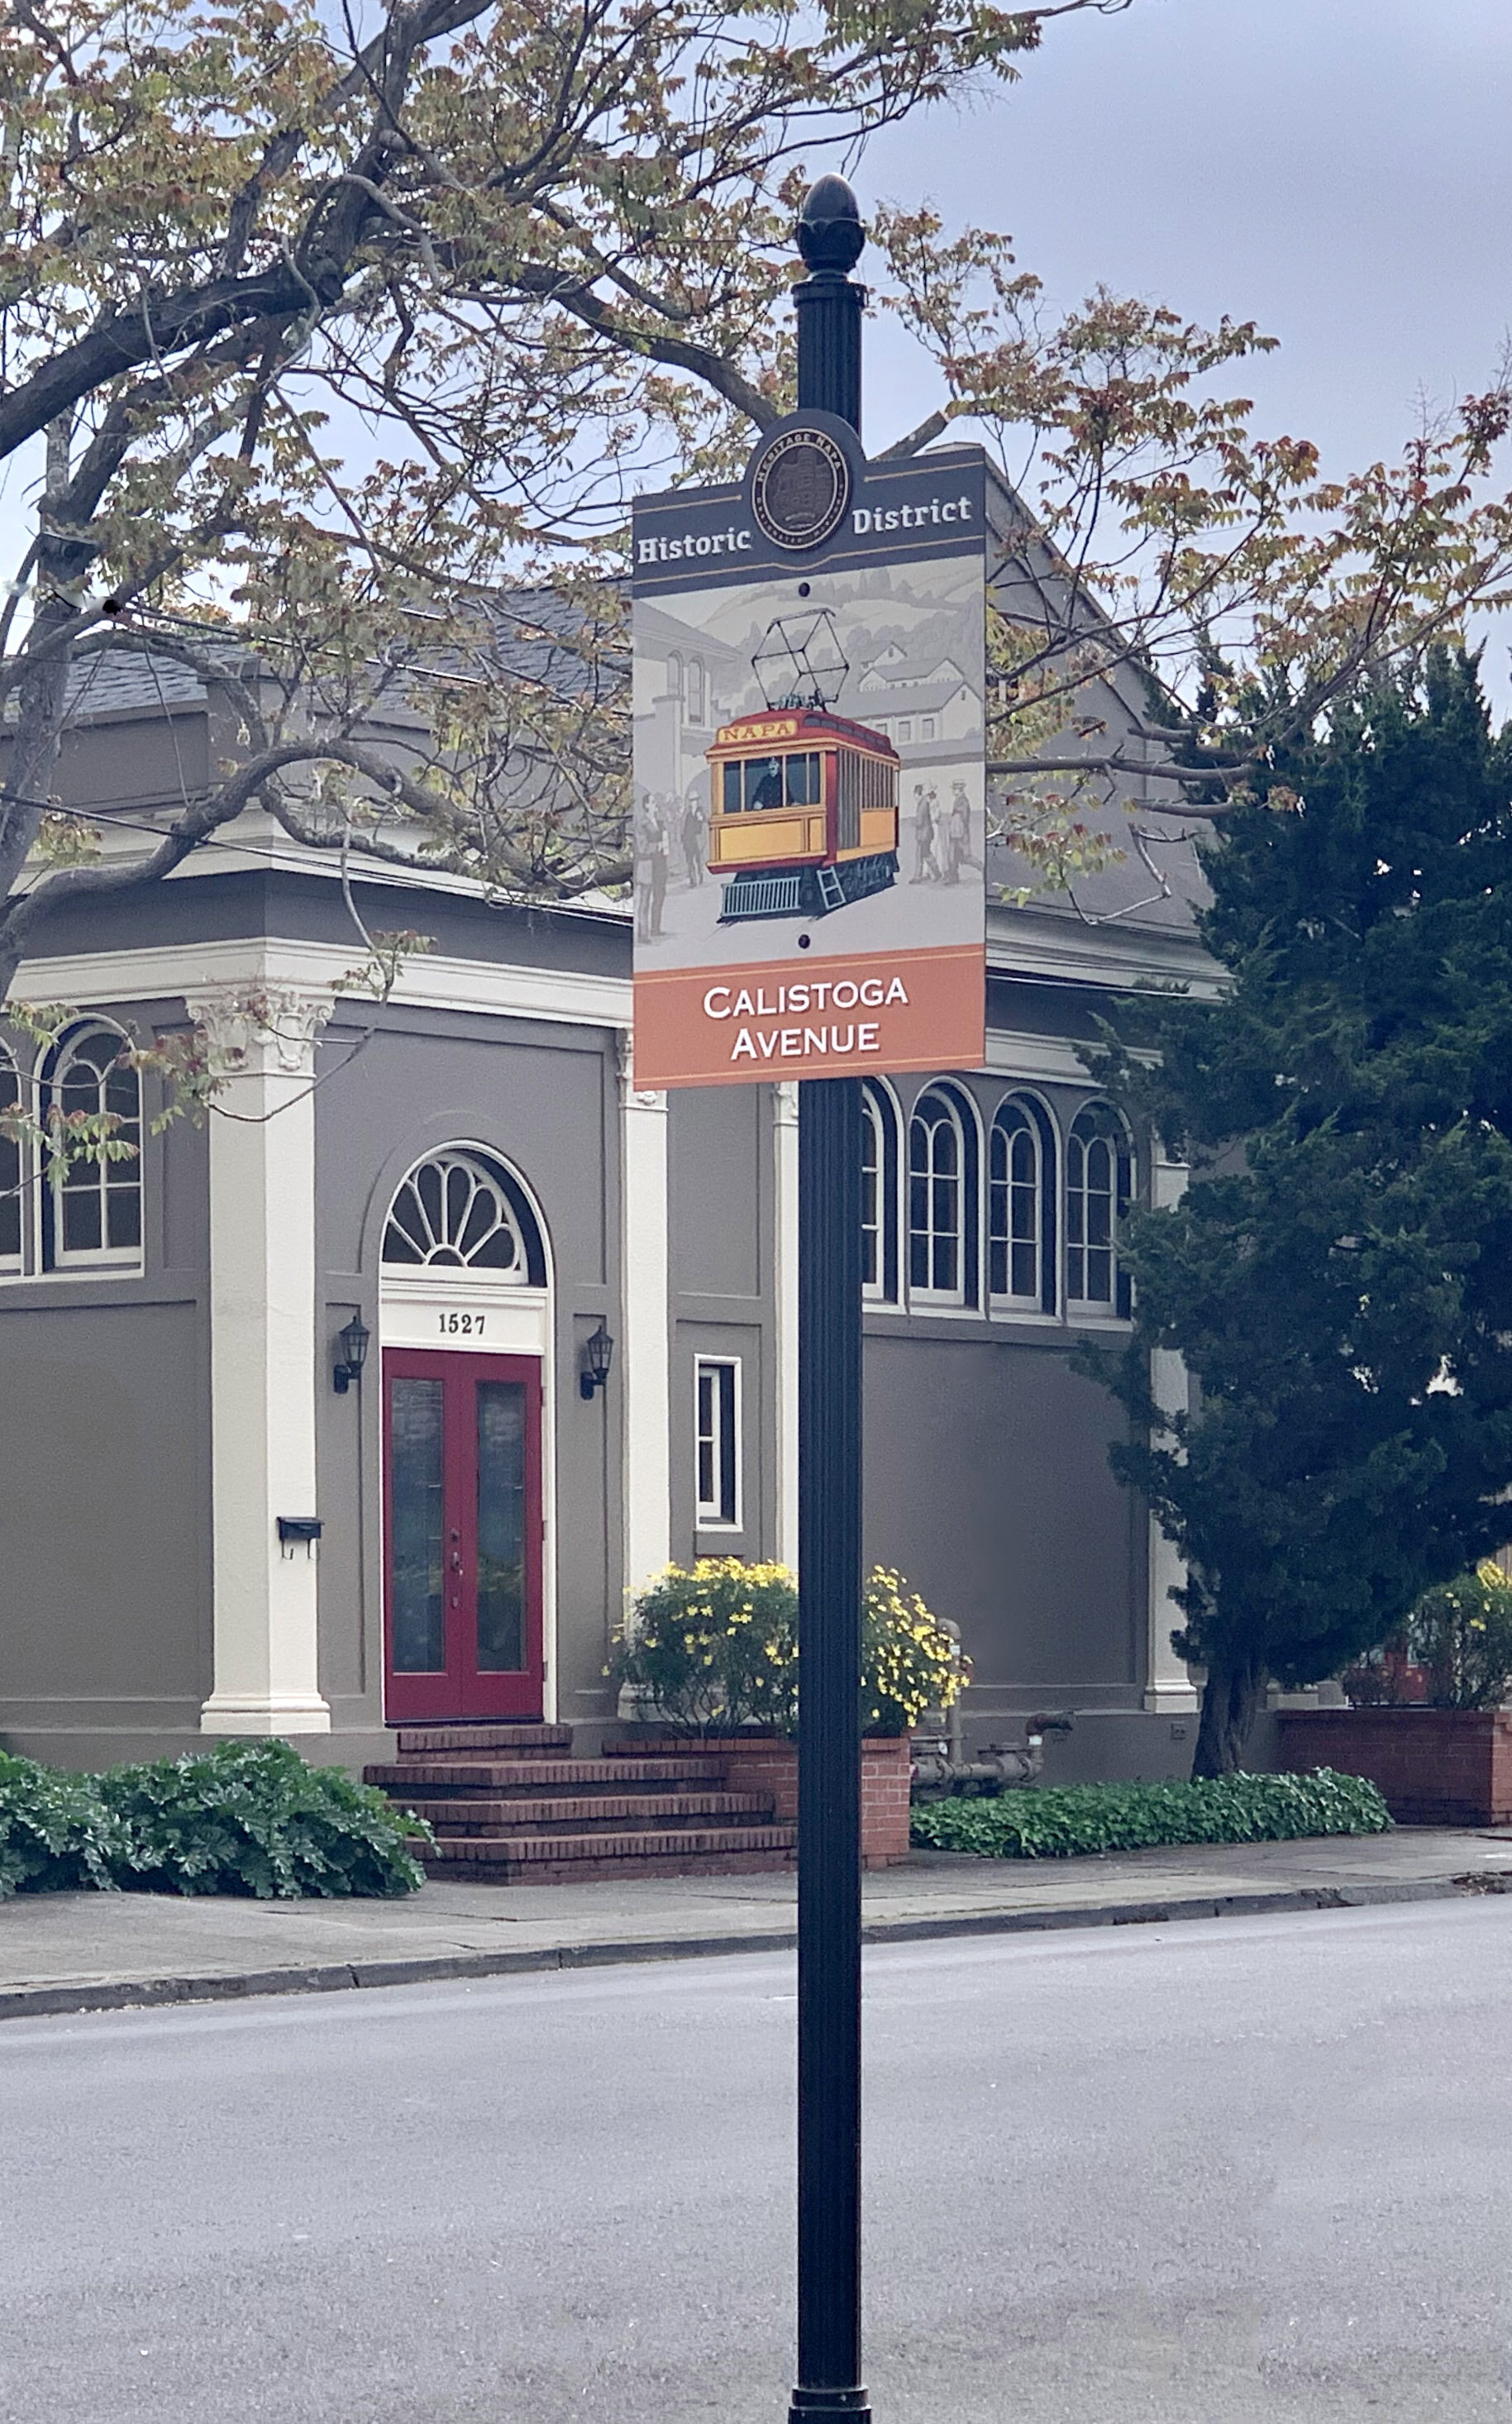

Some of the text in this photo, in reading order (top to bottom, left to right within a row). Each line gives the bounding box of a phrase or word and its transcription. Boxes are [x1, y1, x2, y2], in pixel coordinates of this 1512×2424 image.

[756, 433, 842, 482] HERITAGE NAPA
[637, 527, 751, 564] Historic
[852, 496, 972, 534] District
[723, 723, 790, 741] NAPA
[704, 977, 909, 1019] CALISTOGA
[730, 1023, 880, 1061] AVENUE
[439, 1313, 485, 1335] 1527
